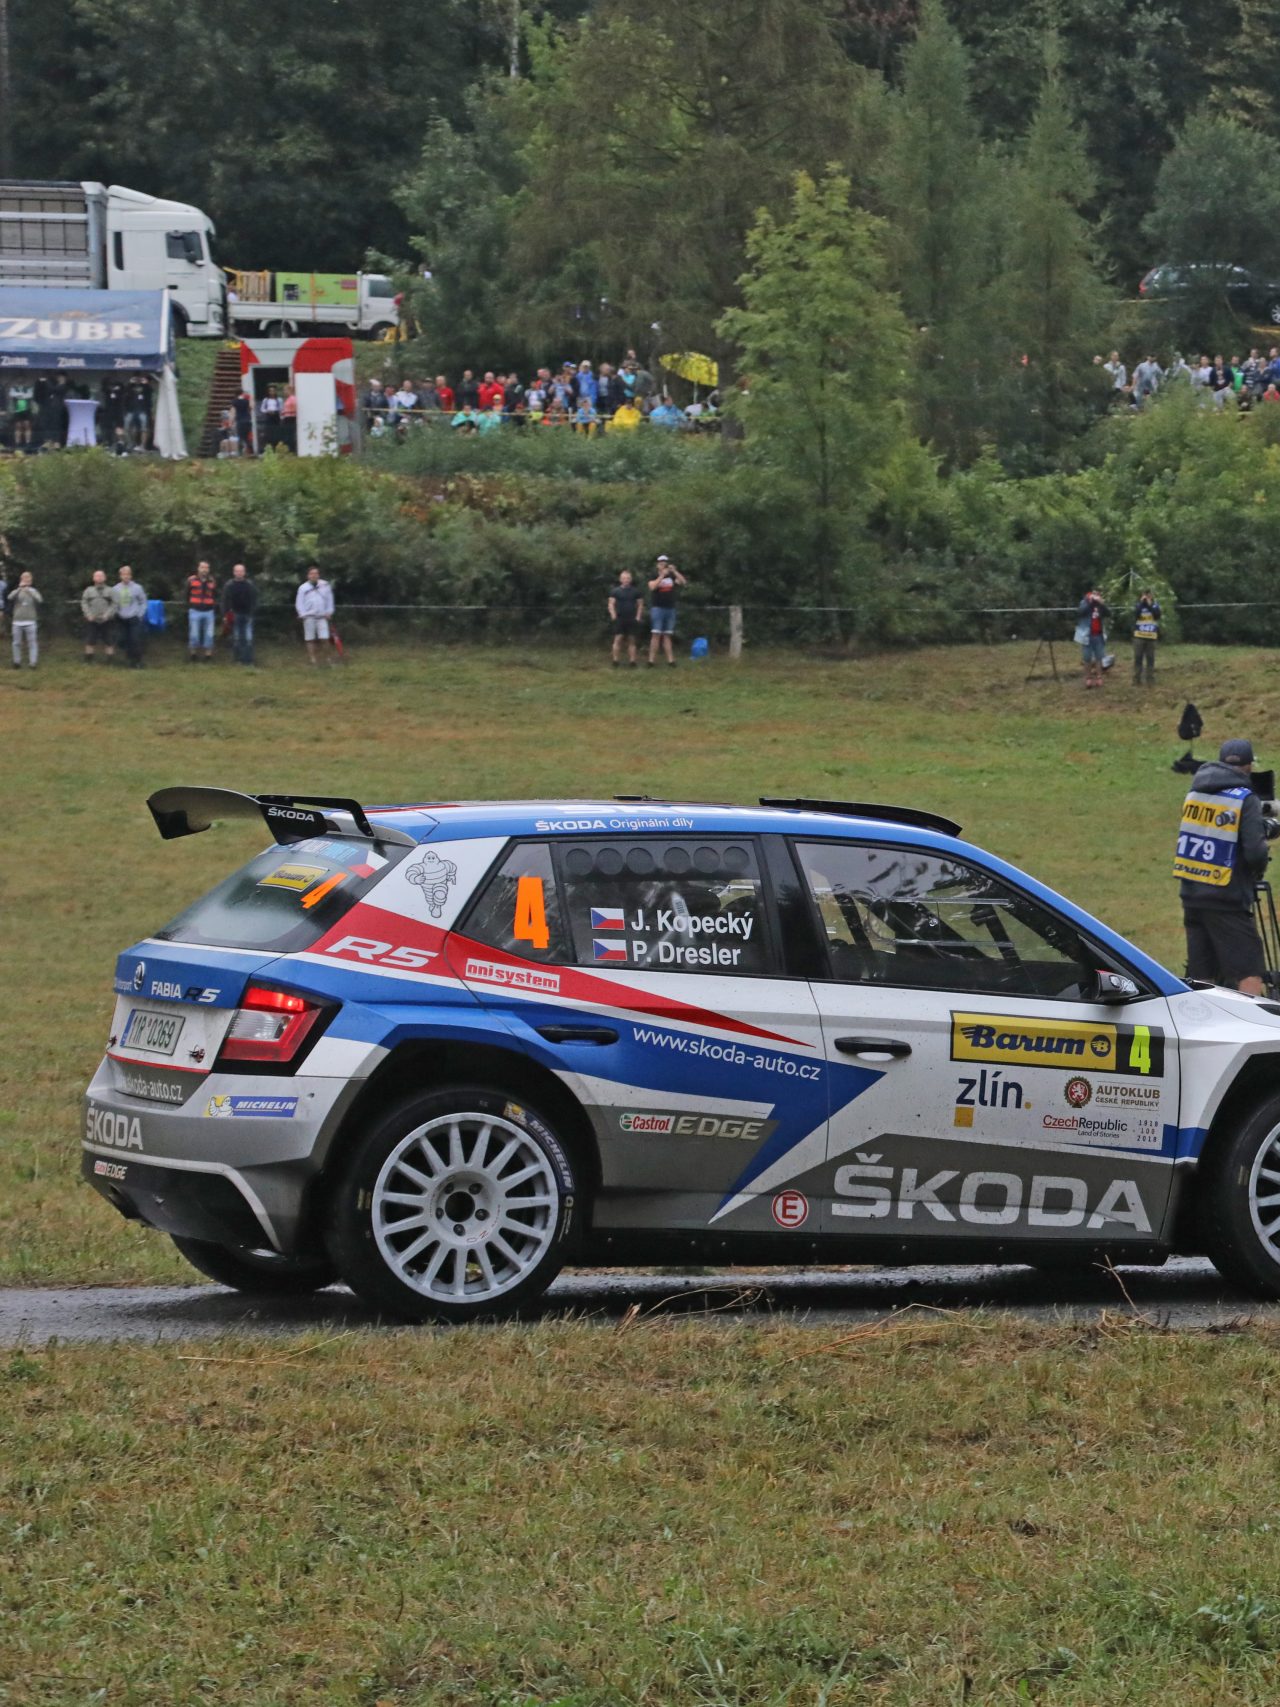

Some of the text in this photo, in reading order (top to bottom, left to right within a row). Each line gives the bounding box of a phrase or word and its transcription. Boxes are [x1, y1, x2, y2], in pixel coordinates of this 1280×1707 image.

[0, 317, 145, 341] ZUBR
[268, 807, 315, 822] ŠKODA
[535, 817, 694, 831] ŠKODA Originální díly
[1177, 834, 1216, 861] 179
[300, 872, 348, 909] 4
[514, 876, 549, 949] 4
[631, 909, 753, 941] J. Kopecký
[325, 935, 439, 968] R5
[632, 941, 741, 966] P. Dresler
[151, 981, 182, 999] FABIA
[183, 986, 221, 1003] R5
[960, 1024, 1086, 1056] Barum
[1129, 1025, 1151, 1074] 4
[633, 1027, 822, 1081] www.skoda-auto.cz
[1096, 1085, 1161, 1099] AUTOKLUB
[1121, 1098, 1160, 1108] REPUBLIKY
[235, 1100, 297, 1111] MICHELIN
[86, 1100, 144, 1151] ŠKODA
[632, 1115, 764, 1140] Castrol EDGE
[1100, 1131, 1120, 1139] Stories
[106, 1163, 128, 1180] EDGE
[832, 1152, 1152, 1233] ŠKODA
[781, 1196, 798, 1220] E
